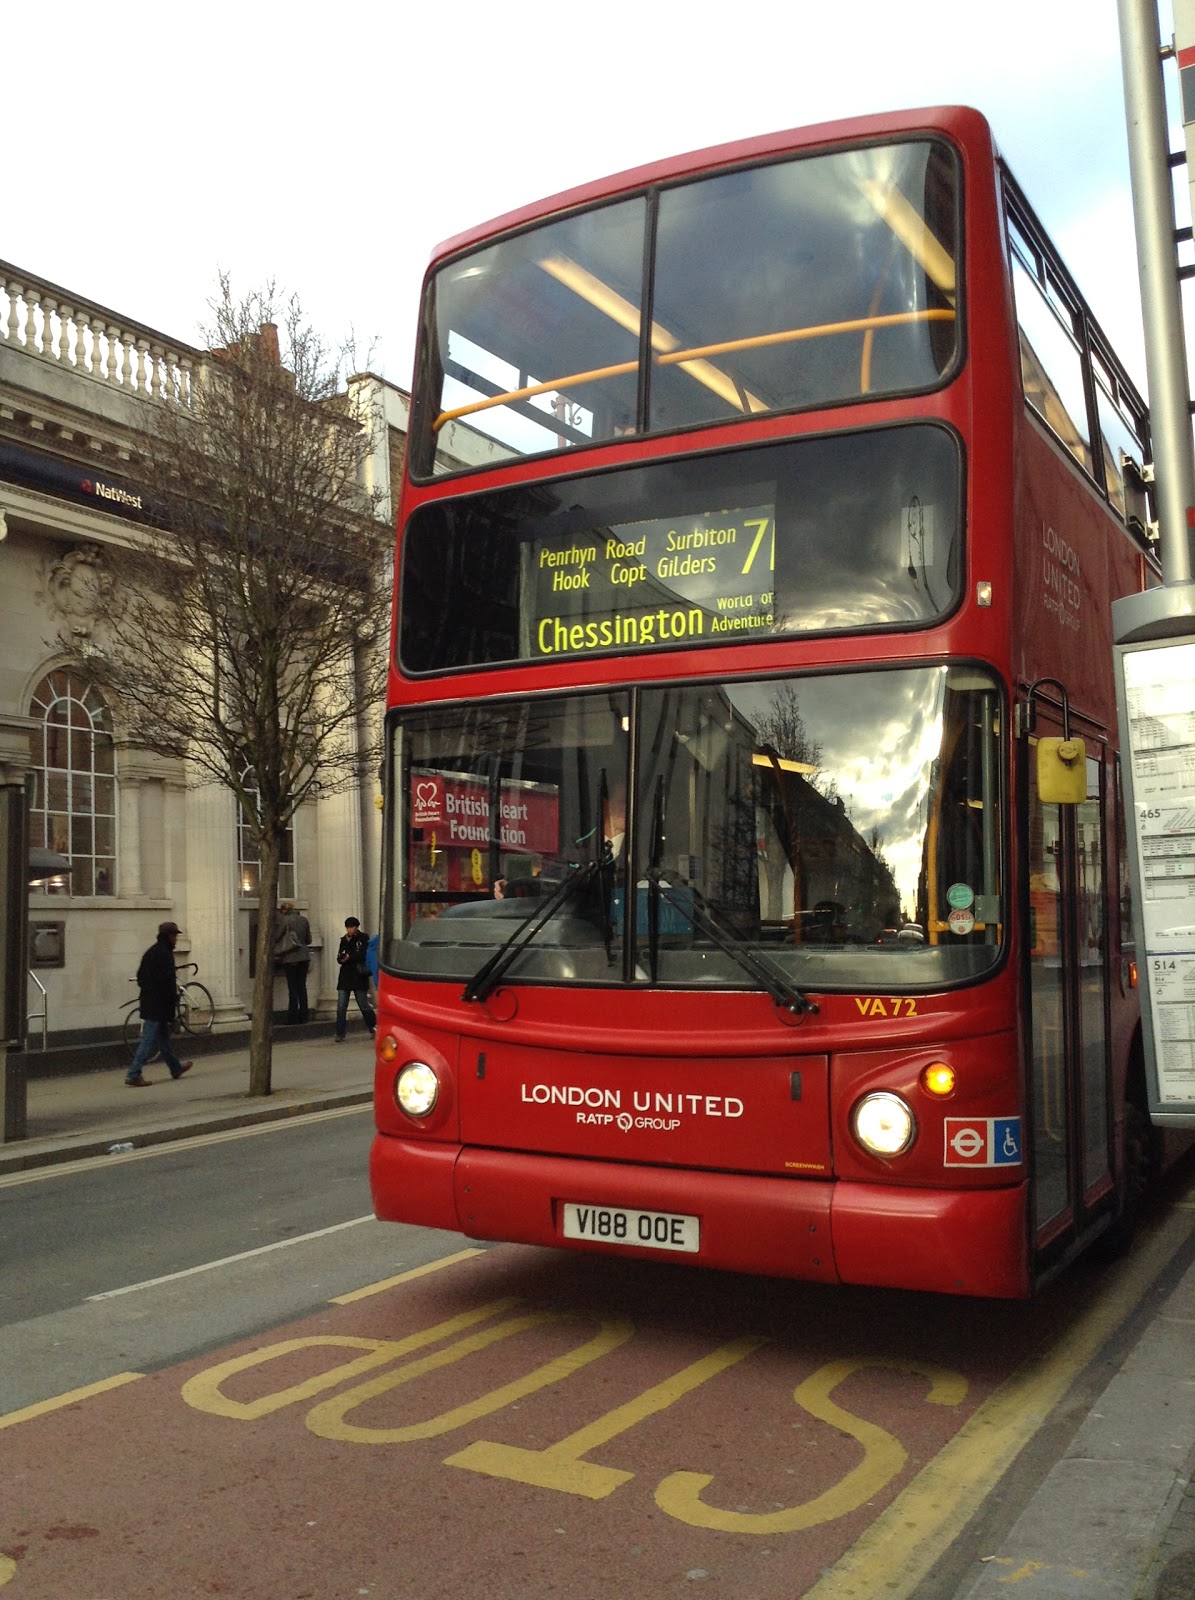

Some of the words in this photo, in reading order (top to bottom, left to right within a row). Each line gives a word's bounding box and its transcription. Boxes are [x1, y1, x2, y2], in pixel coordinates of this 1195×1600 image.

[95, 482, 142, 509] NatWest
[539, 546, 597, 570] Penrhyn
[605, 535, 647, 560] Road
[666, 527, 737, 552] Surbiton
[1042, 521, 1080, 577] LONDON
[552, 568, 591, 592] Hook
[610, 563, 647, 588] Copt
[657, 555, 717, 579] Gilders
[1043, 558, 1080, 610] UNITED
[717, 593, 753, 611] World
[538, 608, 703, 653] Chessington
[711, 613, 774, 633] Adventure
[445, 792, 490, 818] British
[499, 798, 529, 821] eart
[1140, 809, 1161, 819] 465
[449, 819, 527, 845] Fountion
[1154, 960, 1176, 971] 514
[520, 1083, 622, 1110] LONDON
[632, 1091, 745, 1119] UNITED
[575, 1112, 614, 1127] RATP
[634, 1116, 682, 1132] GROUP
[576, 1208, 627, 1239] V188
[181, 1296, 969, 1535] STOP
